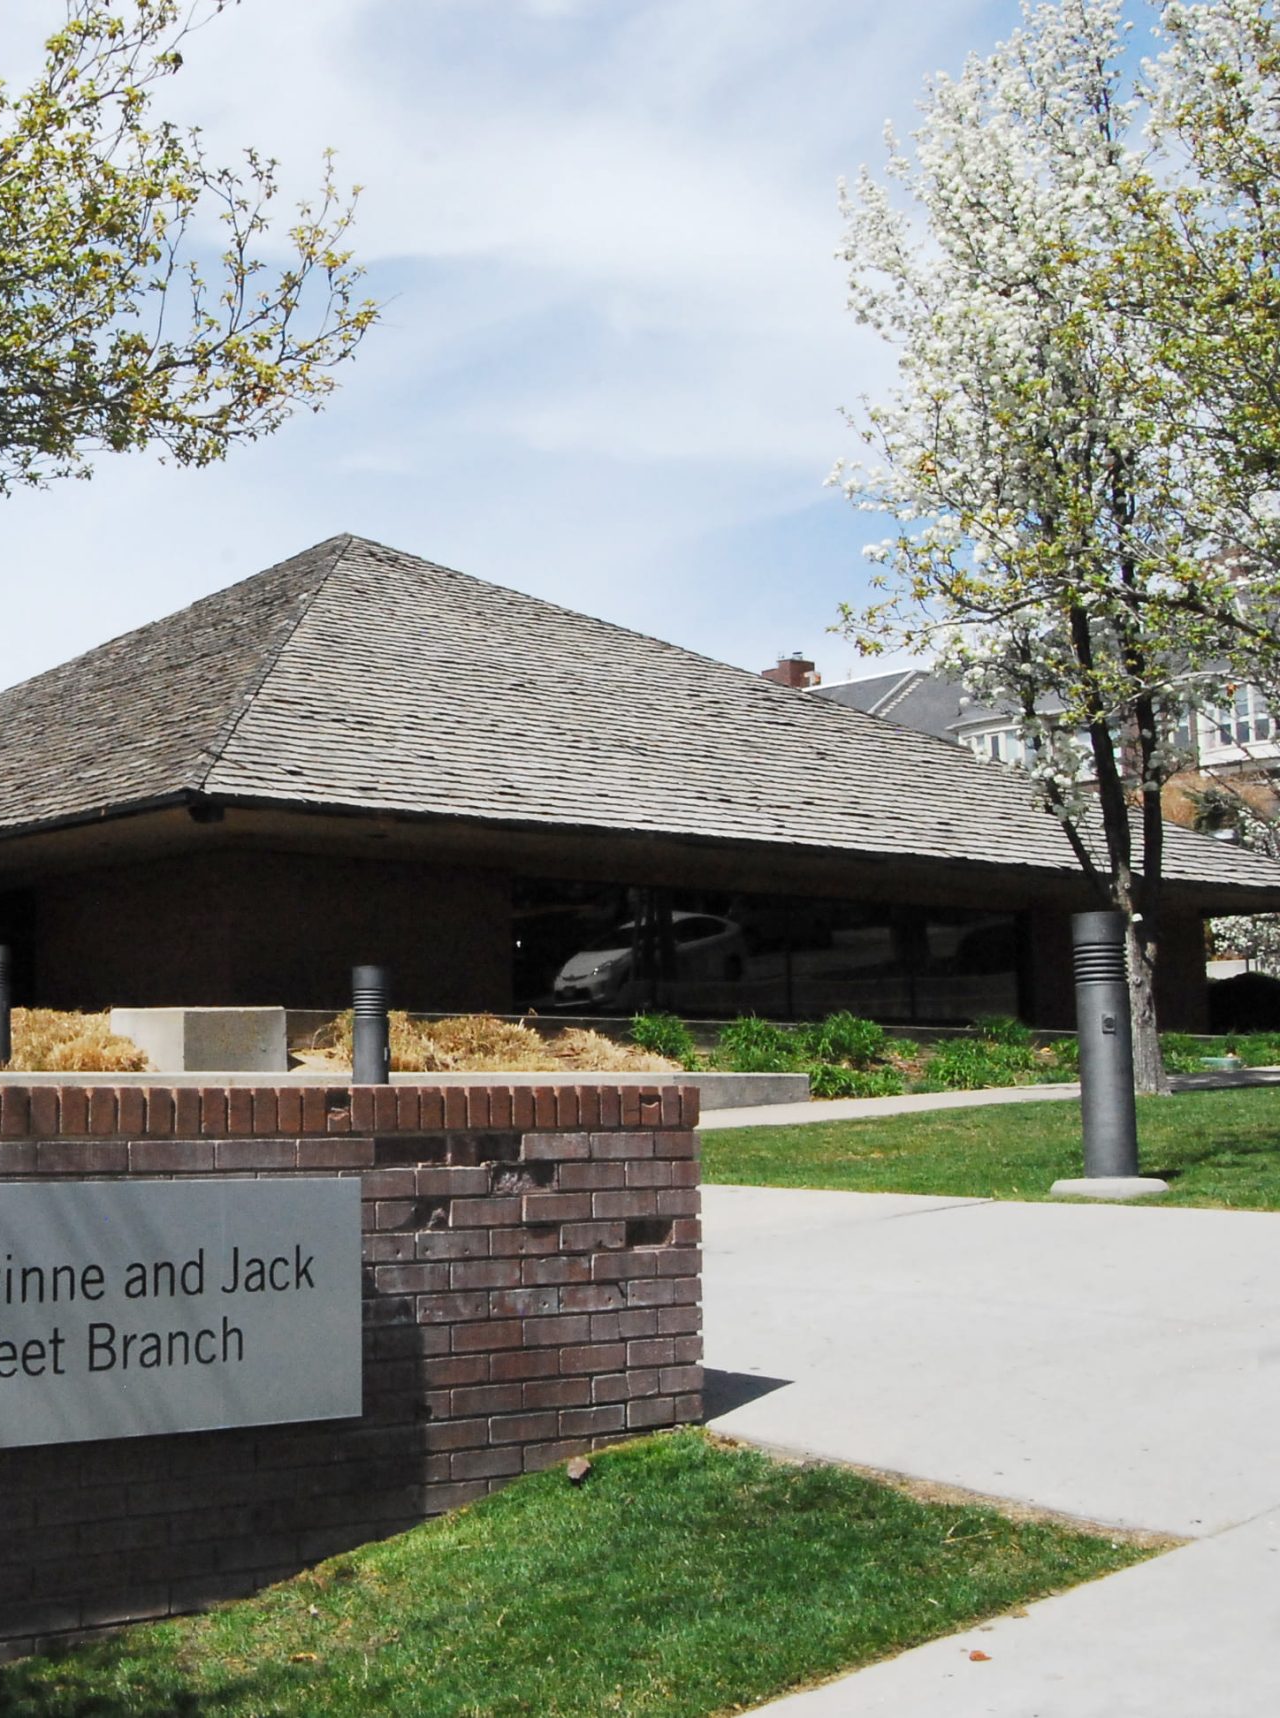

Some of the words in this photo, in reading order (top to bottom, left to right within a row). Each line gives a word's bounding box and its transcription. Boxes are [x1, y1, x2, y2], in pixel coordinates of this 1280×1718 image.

[124, 1247, 204, 1299] and
[220, 1244, 315, 1294] Jack
[88, 1315, 244, 1373] Branch
